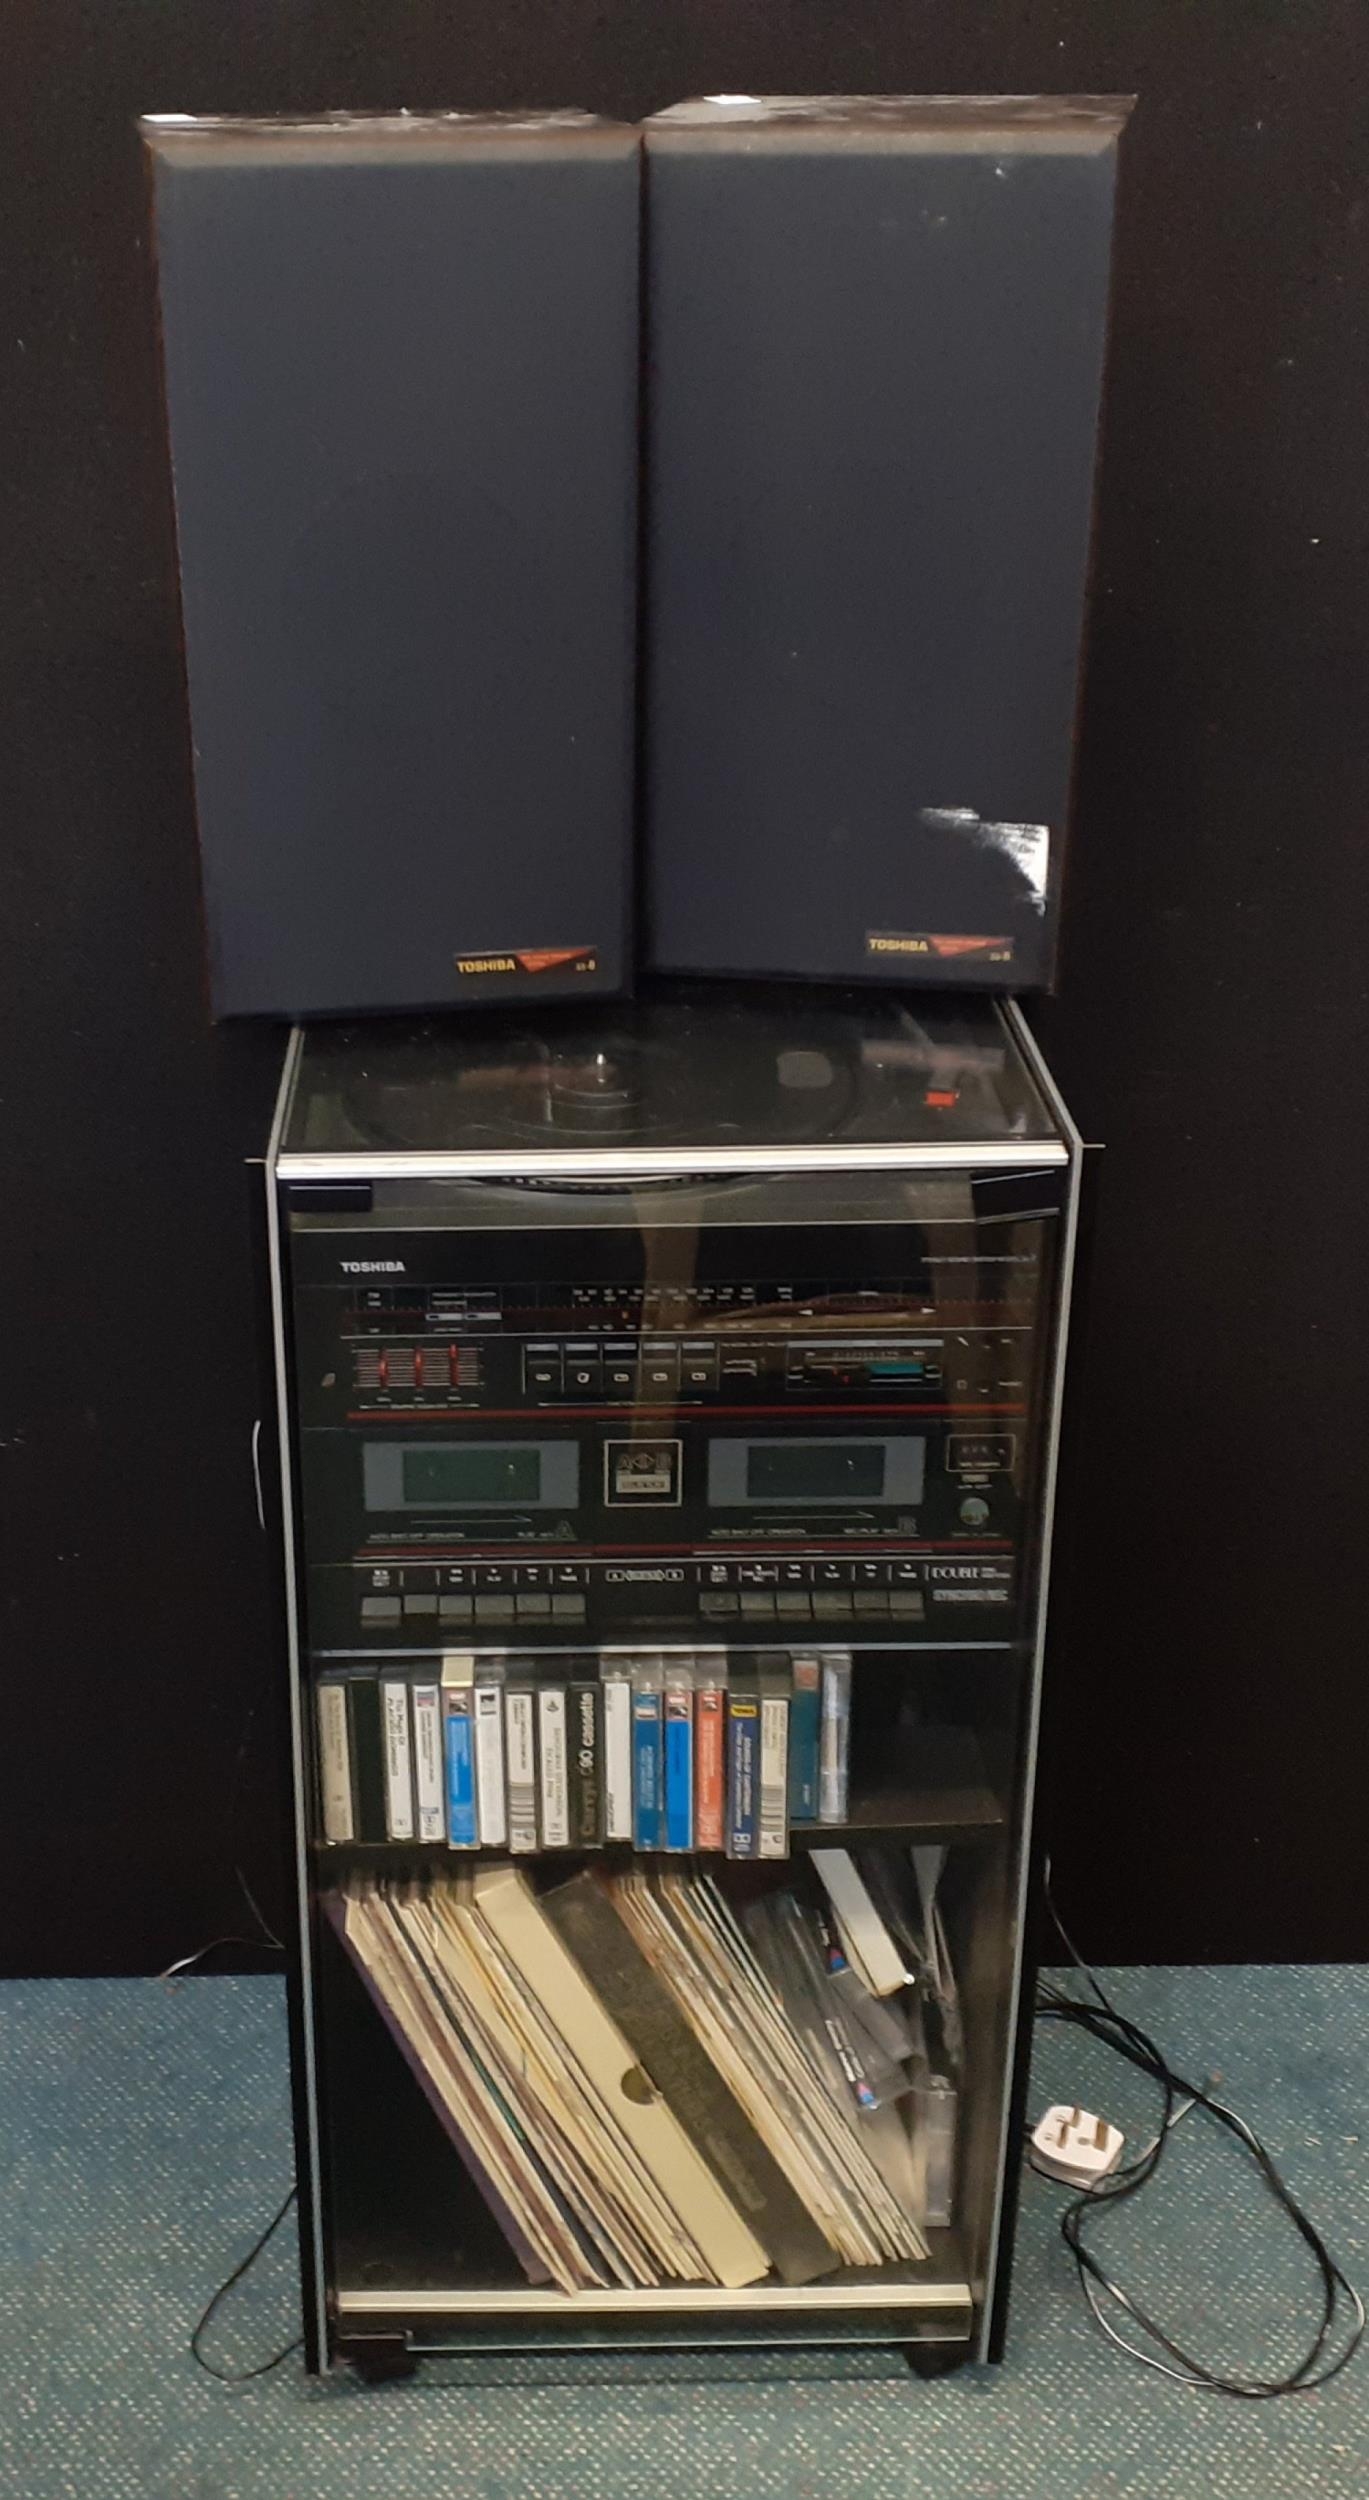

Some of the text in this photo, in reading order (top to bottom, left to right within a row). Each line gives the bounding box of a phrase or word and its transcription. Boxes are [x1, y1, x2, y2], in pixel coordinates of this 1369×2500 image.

[869, 938, 928, 952] TOSHIBA
[457, 957, 516, 974] TOSHIBA
[340, 1260, 406, 1273] TOSHIBA
[580, 1692, 594, 1748] cassette
